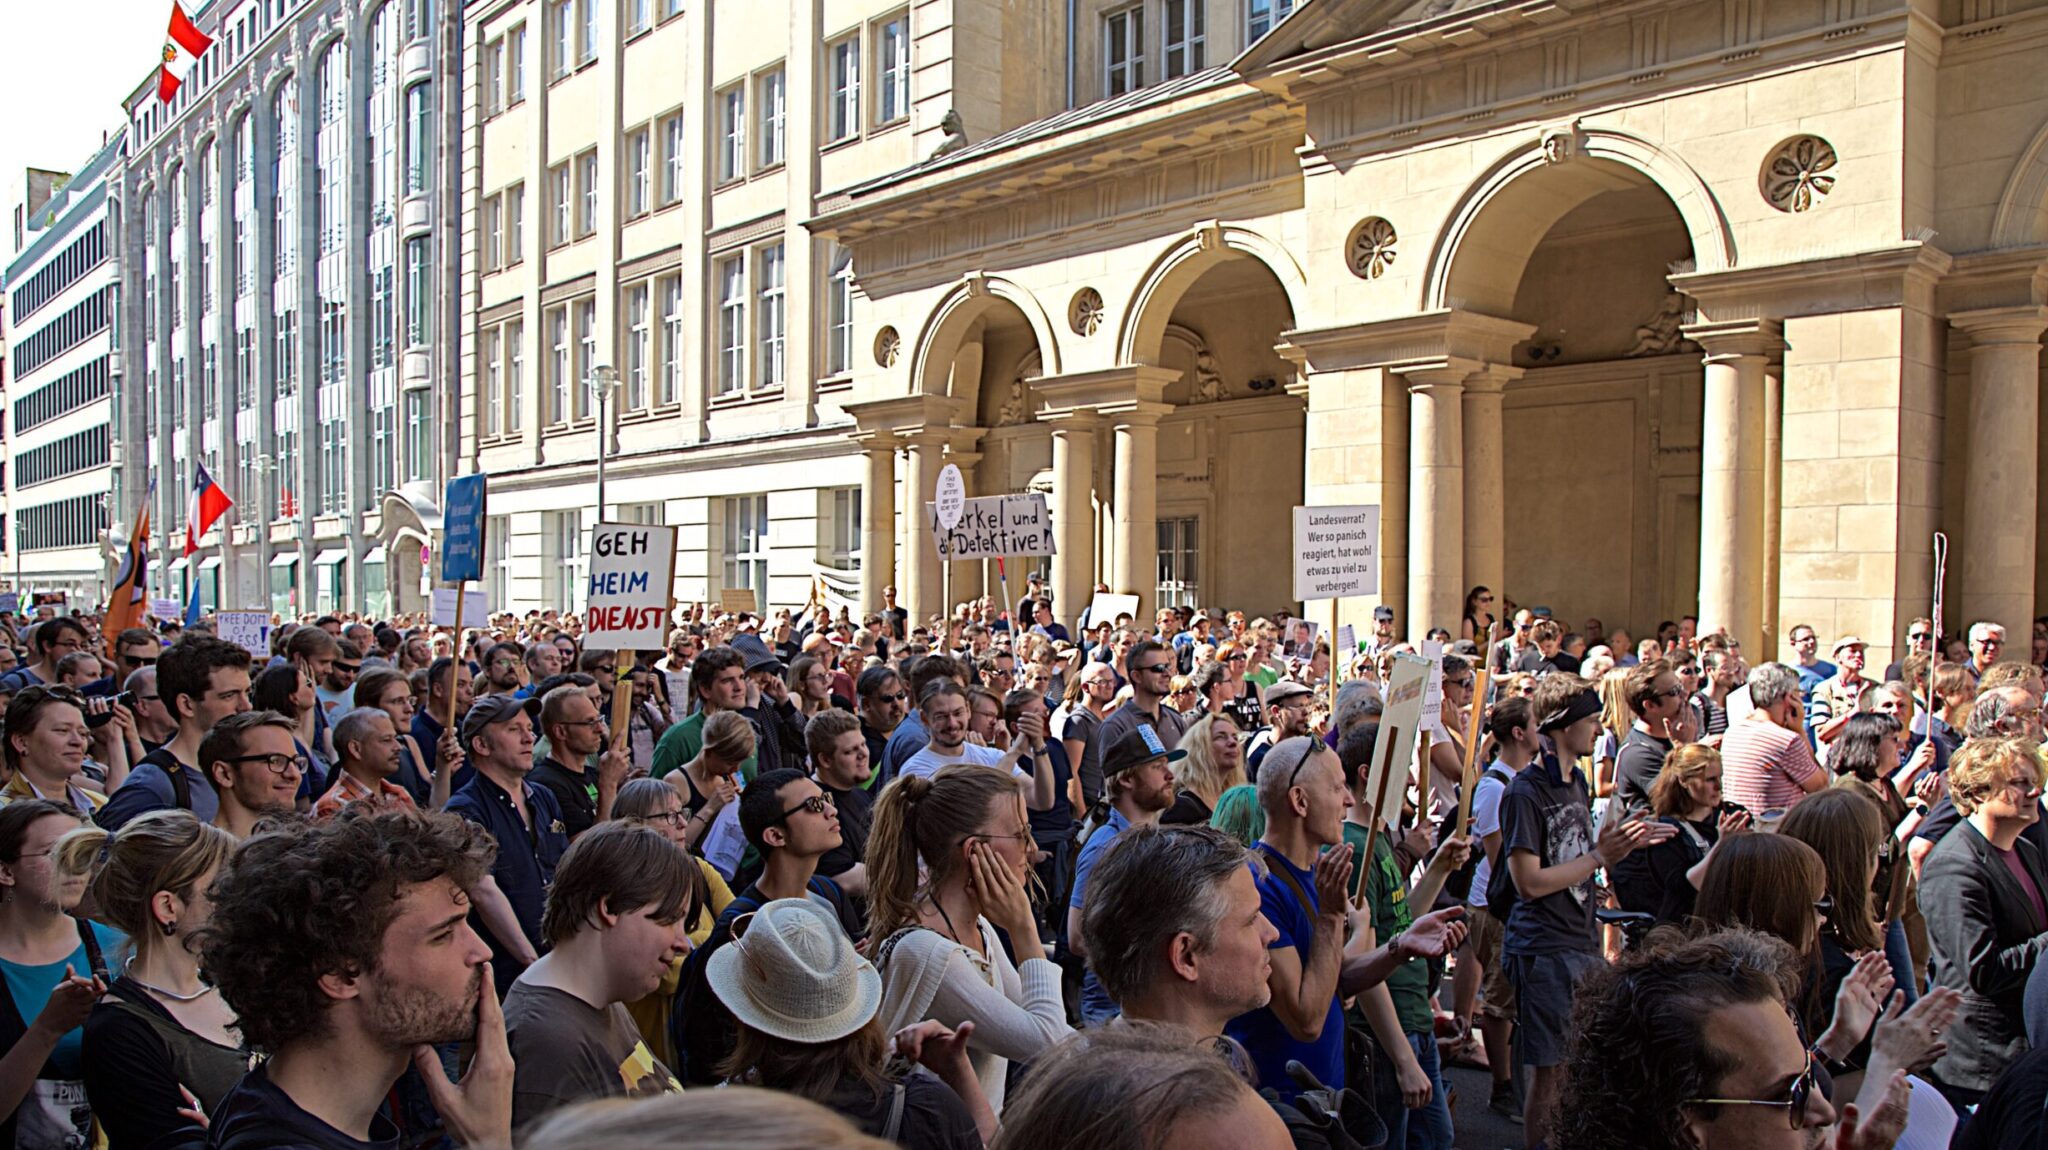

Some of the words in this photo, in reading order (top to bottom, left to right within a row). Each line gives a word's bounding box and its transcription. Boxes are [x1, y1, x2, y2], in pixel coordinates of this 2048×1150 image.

[934, 500, 1004, 533] erkel
[1012, 503, 1039, 525] und
[1309, 513, 1366, 526] Landesverrat?
[596, 531, 648, 557] GEH
[955, 529, 1050, 555] Detektive!
[1308, 531, 1324, 543] Wer
[1325, 533, 1335, 542] so
[1336, 529, 1367, 543] panisch
[1302, 548, 1337, 562] reagiert,
[1338, 547, 1351, 558] hat
[1353, 545, 1372, 556] wohl
[1306, 566, 1330, 576] etwas
[1331, 566, 1341, 575] zu
[1342, 563, 1357, 573] viel
[1358, 564, 1367, 573] zu
[590, 571, 648, 596] HEIM
[1315, 579, 1359, 593] verbergen!
[588, 605, 666, 633] DIENST
